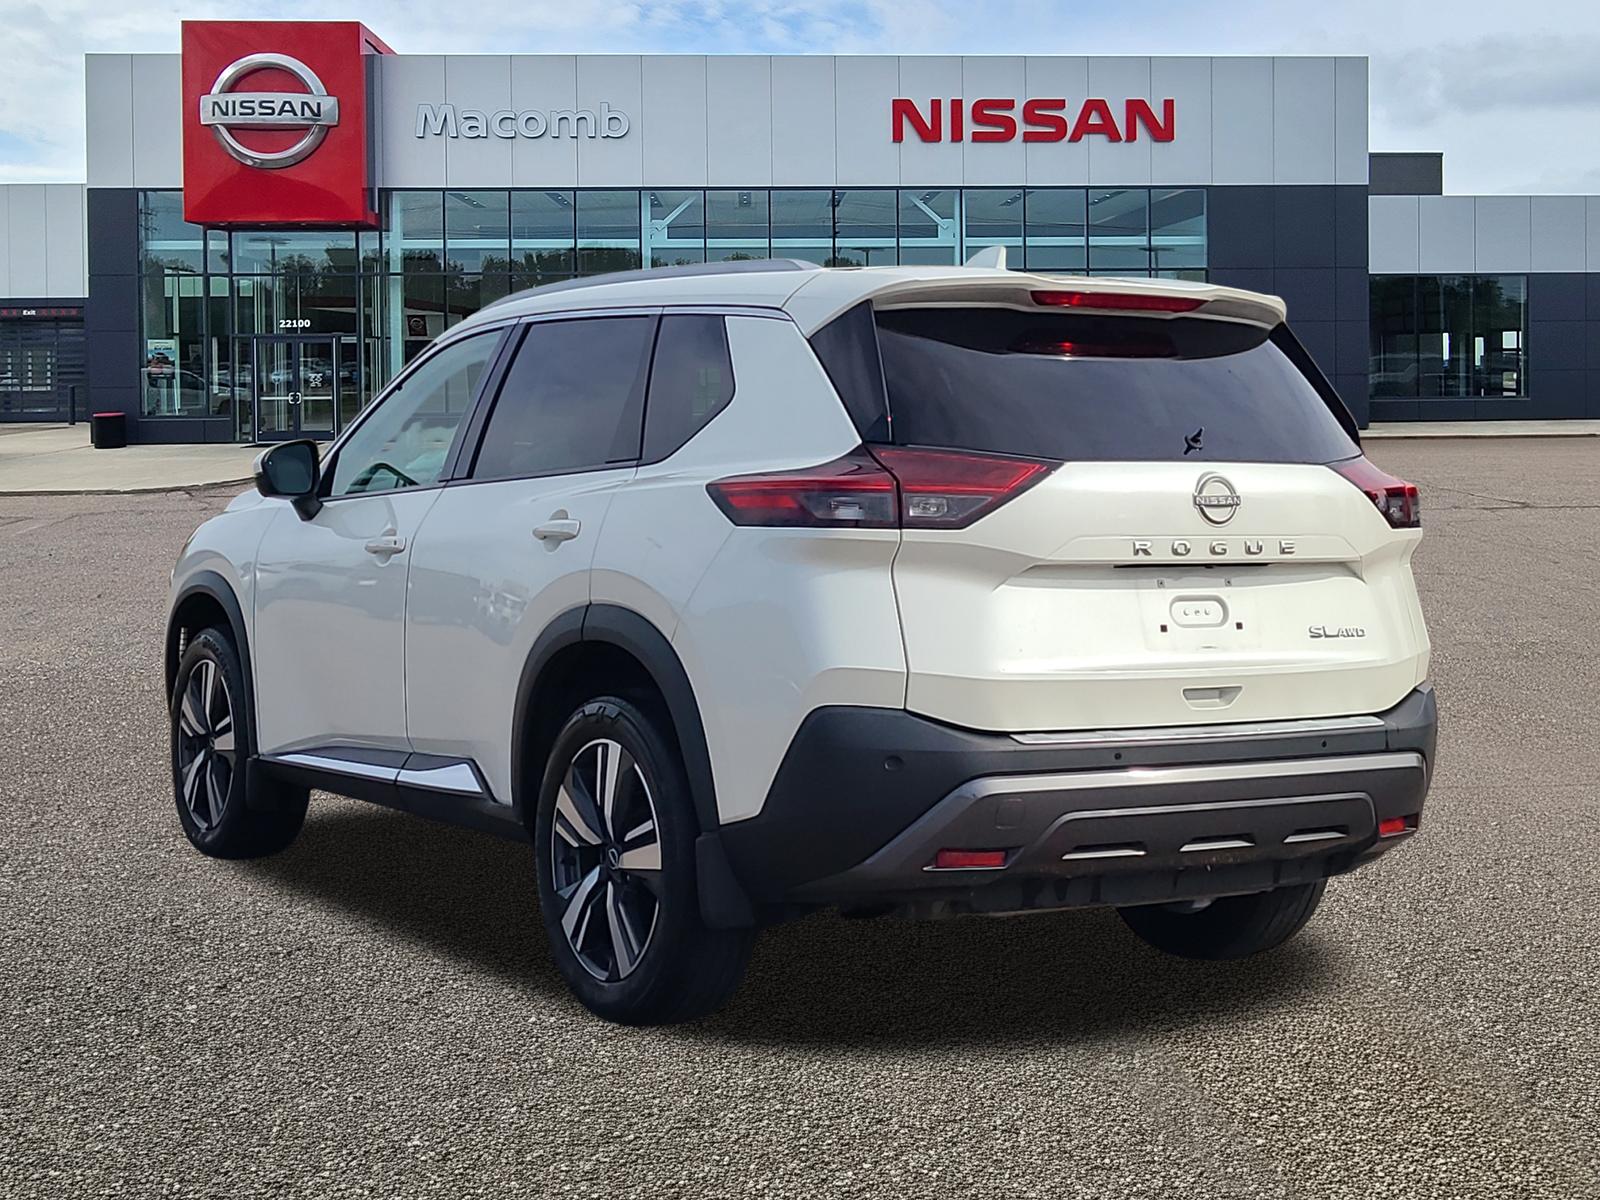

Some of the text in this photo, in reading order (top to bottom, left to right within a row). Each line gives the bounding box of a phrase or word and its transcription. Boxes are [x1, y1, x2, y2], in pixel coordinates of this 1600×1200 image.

[212, 100, 322, 117] NISSAN
[415, 102, 630, 138] Macomb
[892, 98, 1175, 142] NISSAN
[279, 319, 311, 328] 22100
[1195, 496, 1241, 505] NISSAN
[1133, 540, 1296, 556] ROGUE
